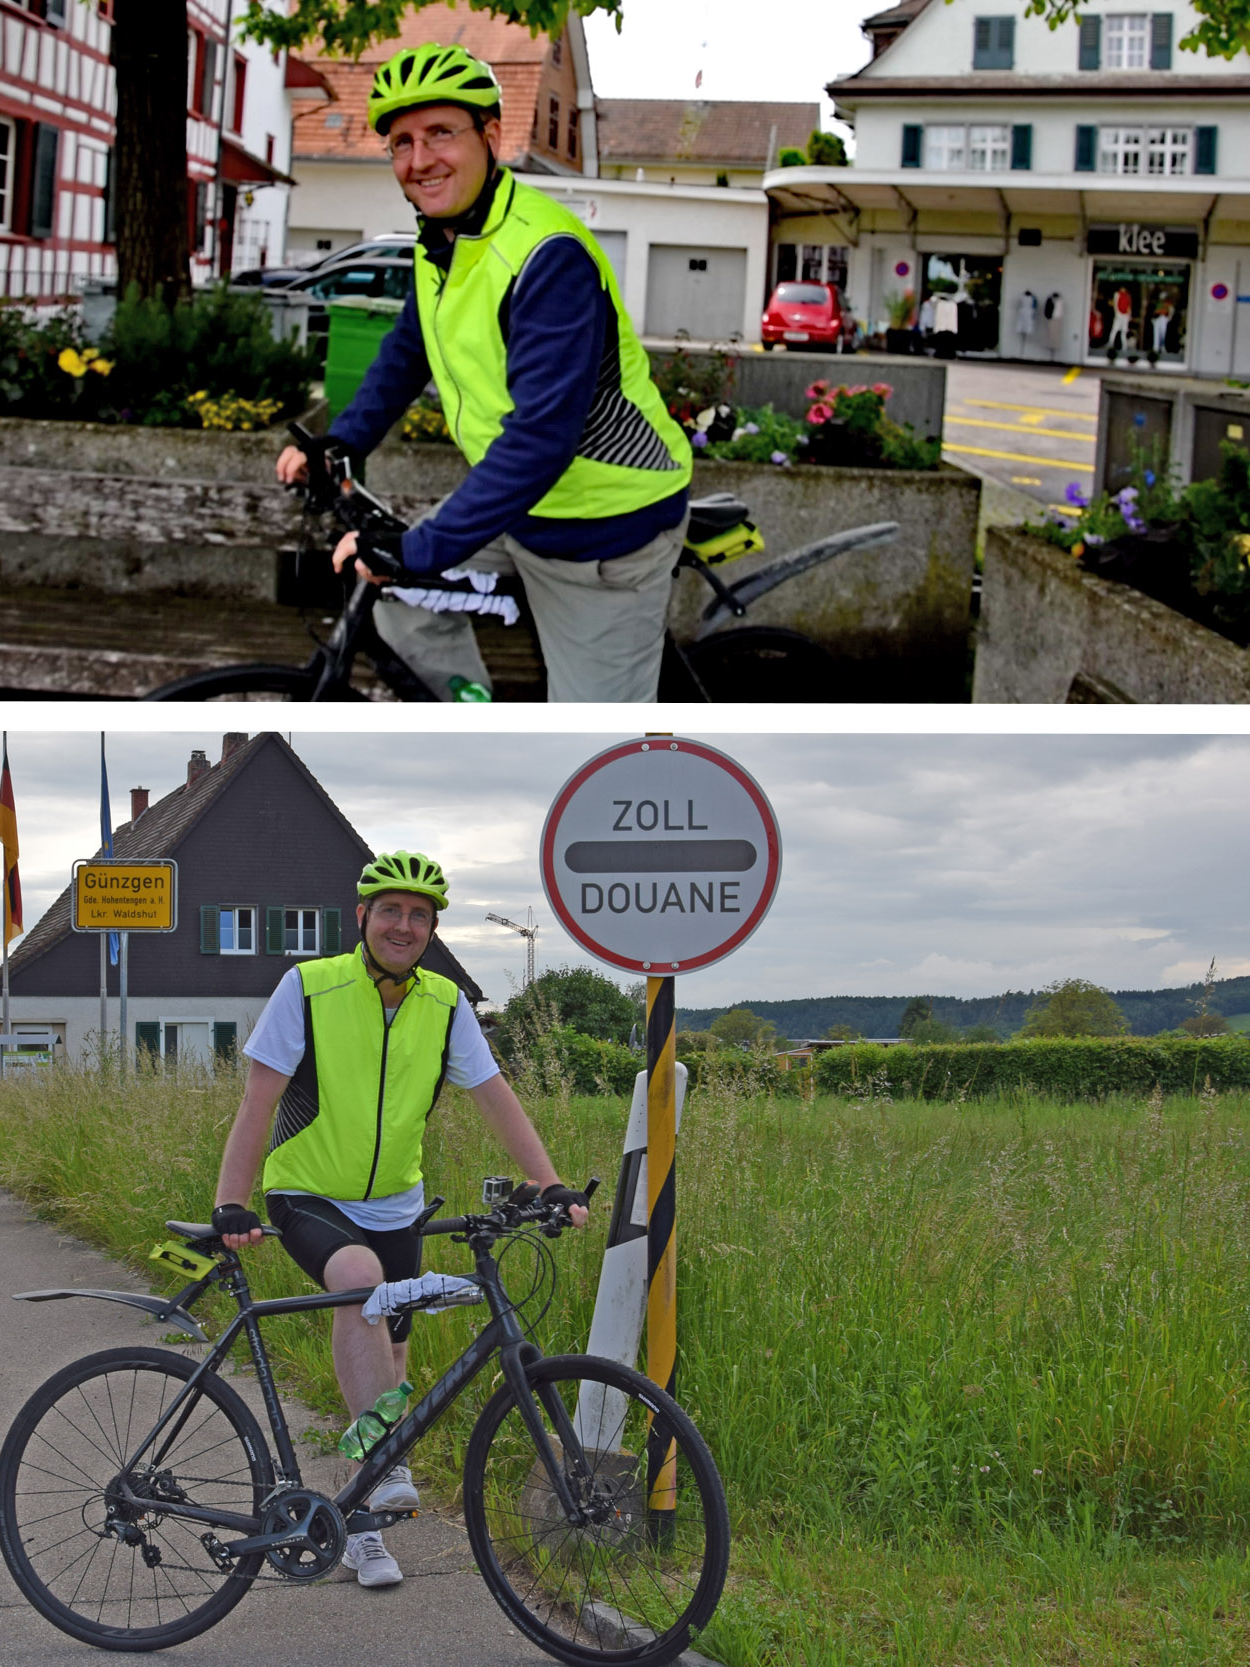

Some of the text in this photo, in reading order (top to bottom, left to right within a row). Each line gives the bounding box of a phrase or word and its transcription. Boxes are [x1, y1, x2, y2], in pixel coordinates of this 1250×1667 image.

[612, 799, 708, 831] ZOLL
[84, 873, 165, 892] Günzgen
[83, 896, 98, 904] Gde.
[102, 896, 147, 906] Hohentengen
[581, 882, 740, 914] DOUANE
[91, 910, 157, 918] Lkr. Waldshut
[372, 1343, 478, 1475] STEVENS
